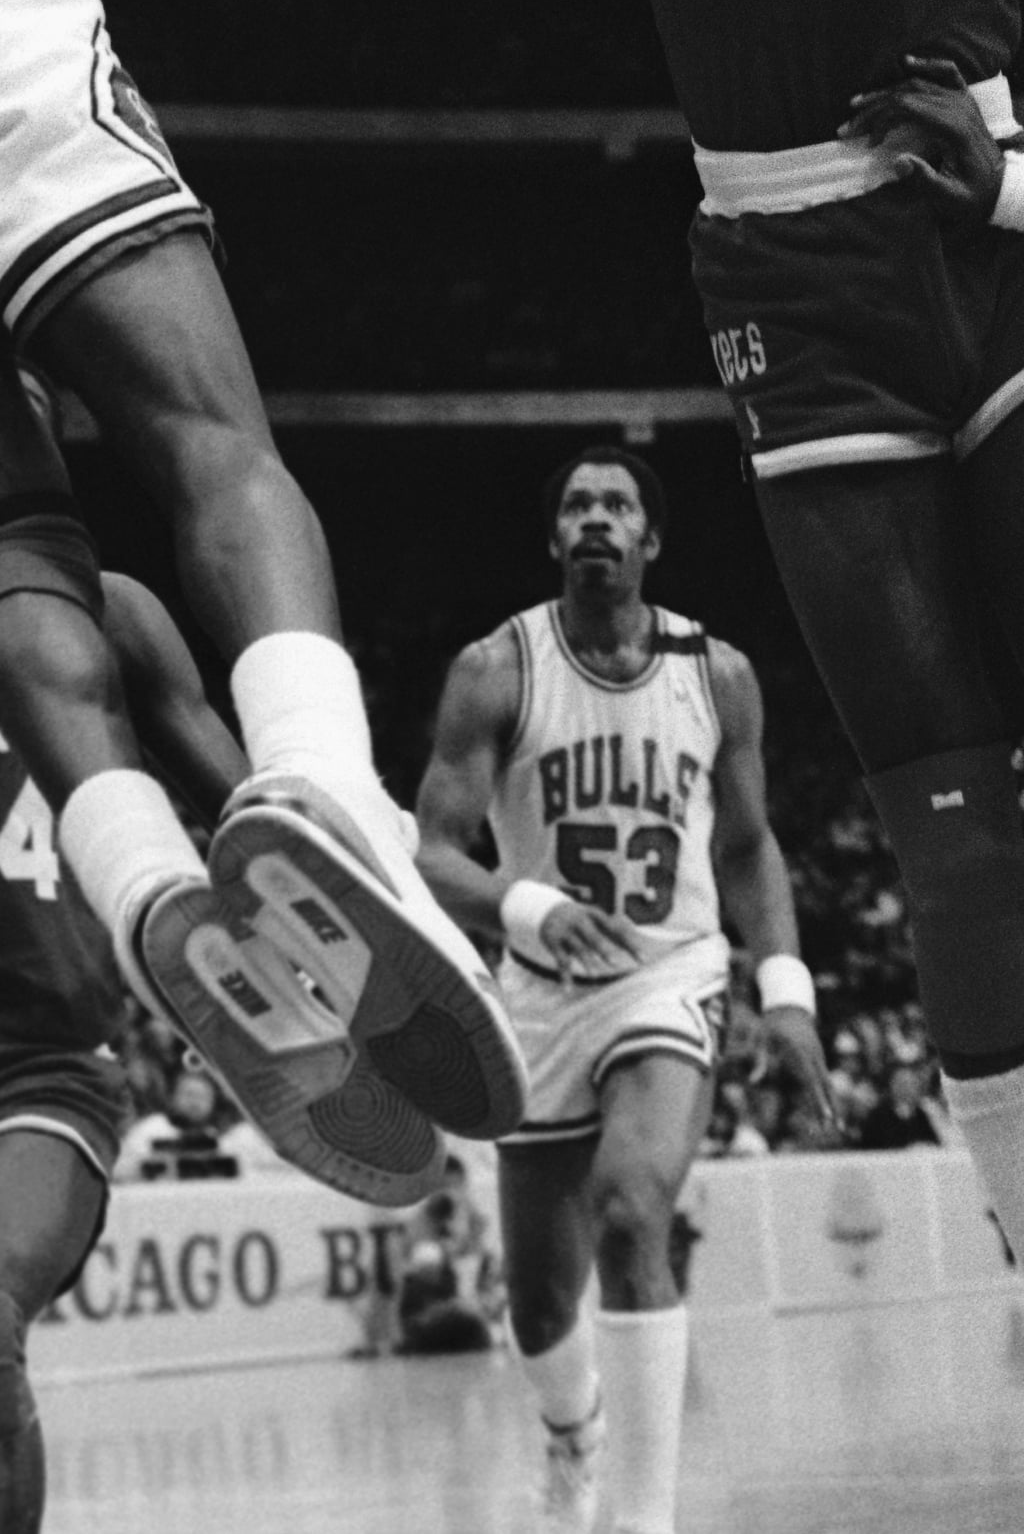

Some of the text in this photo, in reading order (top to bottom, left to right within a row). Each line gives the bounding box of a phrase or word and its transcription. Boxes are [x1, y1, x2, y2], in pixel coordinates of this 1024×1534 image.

[538, 732, 701, 830] BULLS
[555, 820, 681, 926] 53
[39, 1230, 279, 1325] CAGO
